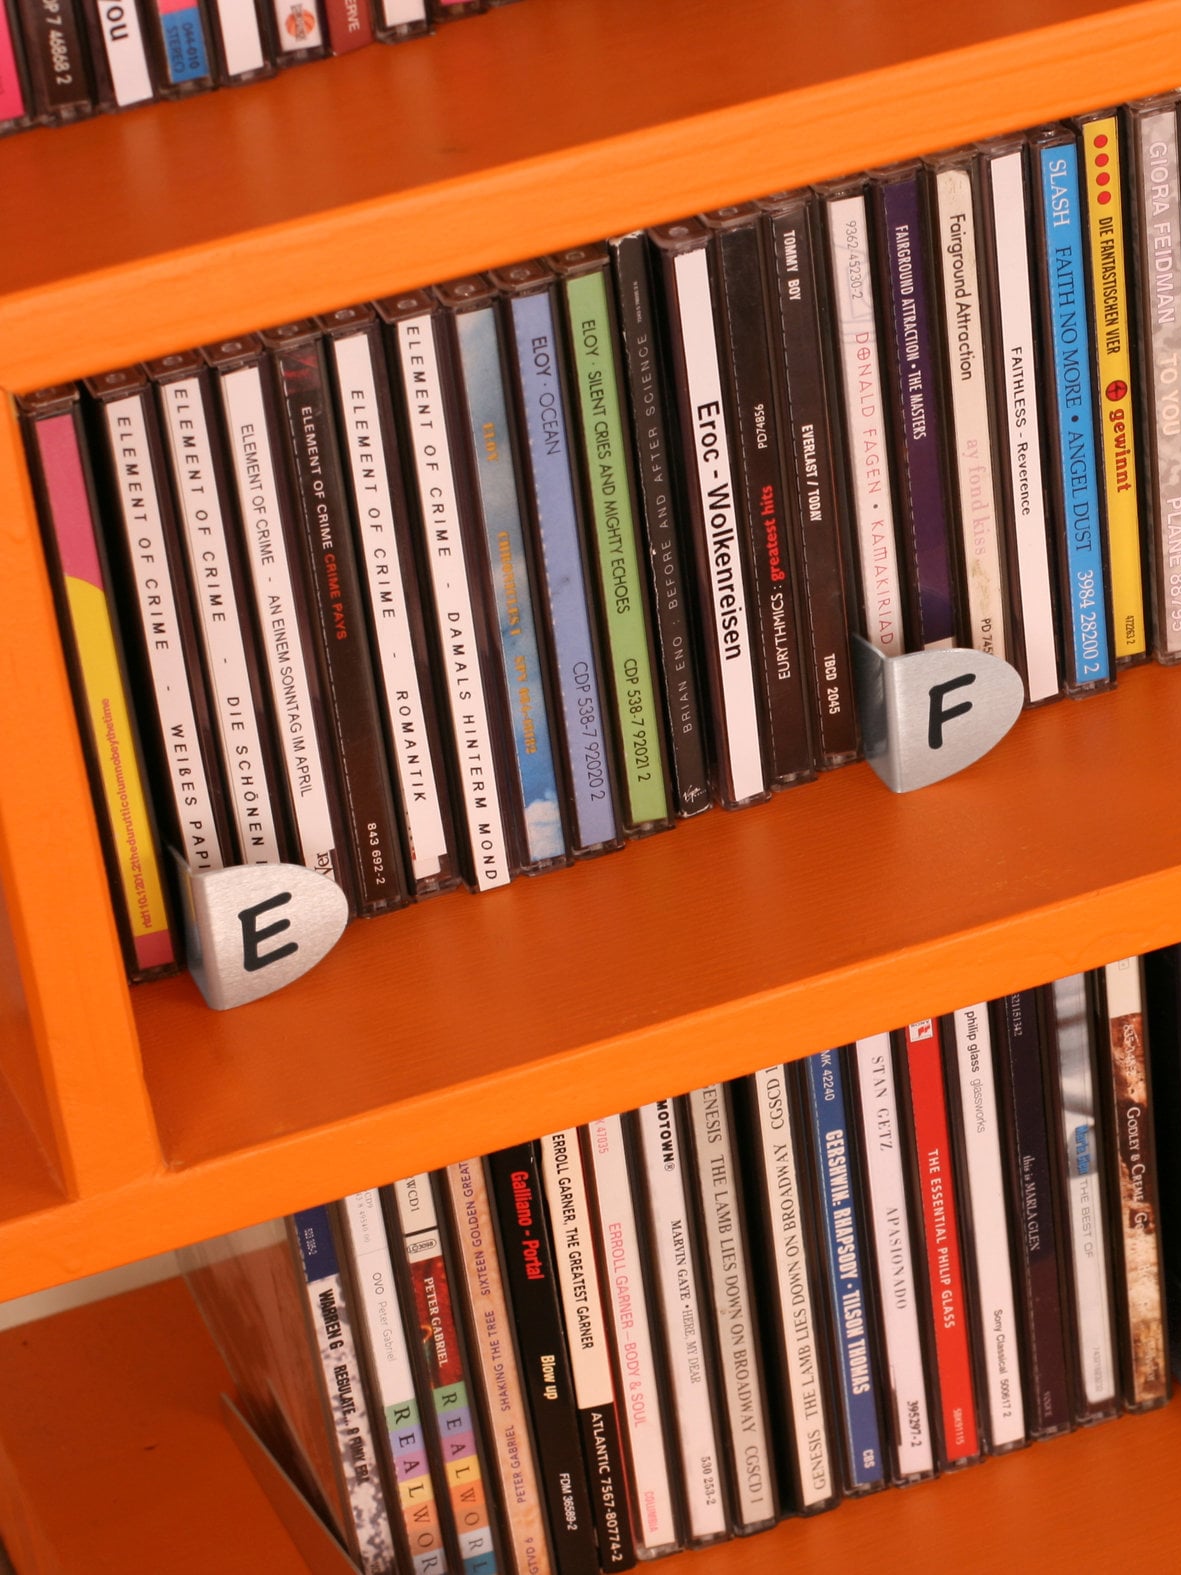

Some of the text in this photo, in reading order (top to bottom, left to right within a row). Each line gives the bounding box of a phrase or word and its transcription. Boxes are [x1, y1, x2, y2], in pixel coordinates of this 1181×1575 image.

[1149, 141, 1170, 217] GIORA
[783, 229, 801, 300] TOMMY BOY
[946, 213, 975, 380] Fairground Attraction
[1153, 222, 1178, 326] FEIDMAN
[636, 333, 655, 416] SCIENCE
[895, 224, 926, 439] FAIRGROUND ATTRACTION THE MASTERS
[1048, 159, 1091, 551] SLASH FAITH NO MORE ANGEL DUST
[1098, 216, 1131, 492] DIE FANTASTISCHEN VIER gewinnt
[1159, 352, 1177, 384] TO
[531, 335, 560, 455] ELOY OCEAN
[647, 426, 663, 481] AFTER
[1010, 346, 1030, 515] FAITHLESS Reverence
[1160, 389, 1180, 435] YOU
[117, 416, 147, 521] ELEMENT
[301, 406, 347, 639] ELEMENT OF CRIME CRIME PAYS
[581, 319, 630, 614] ELOY SILENT CRIES AND MIGHTY ECHOES
[656, 494, 668, 528] AND
[801, 423, 822, 521] EVERLAST TODAY
[138, 537, 154, 562] OF
[661, 539, 677, 609] BEFORE
[697, 400, 743, 661] Eroc Wolkenreisen
[753, 403, 790, 679] EURYTHMICS greatest hits PD74856
[145, 578, 168, 649] CRIME
[173, 388, 264, 846] ELEMENT OF CRIME DIE SCHÖNEN
[240, 423, 312, 797] ELEMENT OF CRIME AN EINEM SONNTAG IM APRIL
[350, 390, 426, 801] ELEMENT OF CRIME ROMANTIK
[406, 326, 497, 879] ELEMENT OF CRIME DAMALS HINTERM MOND
[672, 636, 685, 671] ENO
[678, 680, 692, 733] BRIAN
[823, 652, 840, 714] TBCD 2045
[928, 672, 976, 750] F
[239, 891, 299, 972] E
[963, 1010, 986, 1133] philip glass glassworks
[510, 1170, 544, 1279] Galliano Portal
[551, 1133, 593, 1349] ERROLL GARNER, THE GREATEST GARNER
[871, 1055, 906, 1309] STAN GETZ APASIONADO
[927, 1148, 955, 1328] THE ESSENTIAL PHILIP GLASS
[423, 1276, 448, 1367] PETER GABRIEL
[766, 1078, 825, 1490] GENESIS THE LAMB LIES DOWN ON BROADWAY CGSCD
[825, 1129, 870, 1394] GERSHWIN: RHAPSODY TILSON THOMAS
[465, 1200, 525, 1503] PETER GABRIEL SHAKING THE TREE SIXTEEN GOLDEN
[540, 1354, 558, 1400] Blow up
[608, 1222, 646, 1428] ERROLL GARNER BODY & SOUL
[590, 1412, 623, 1562] ATLANTIC 7567-80774-2
